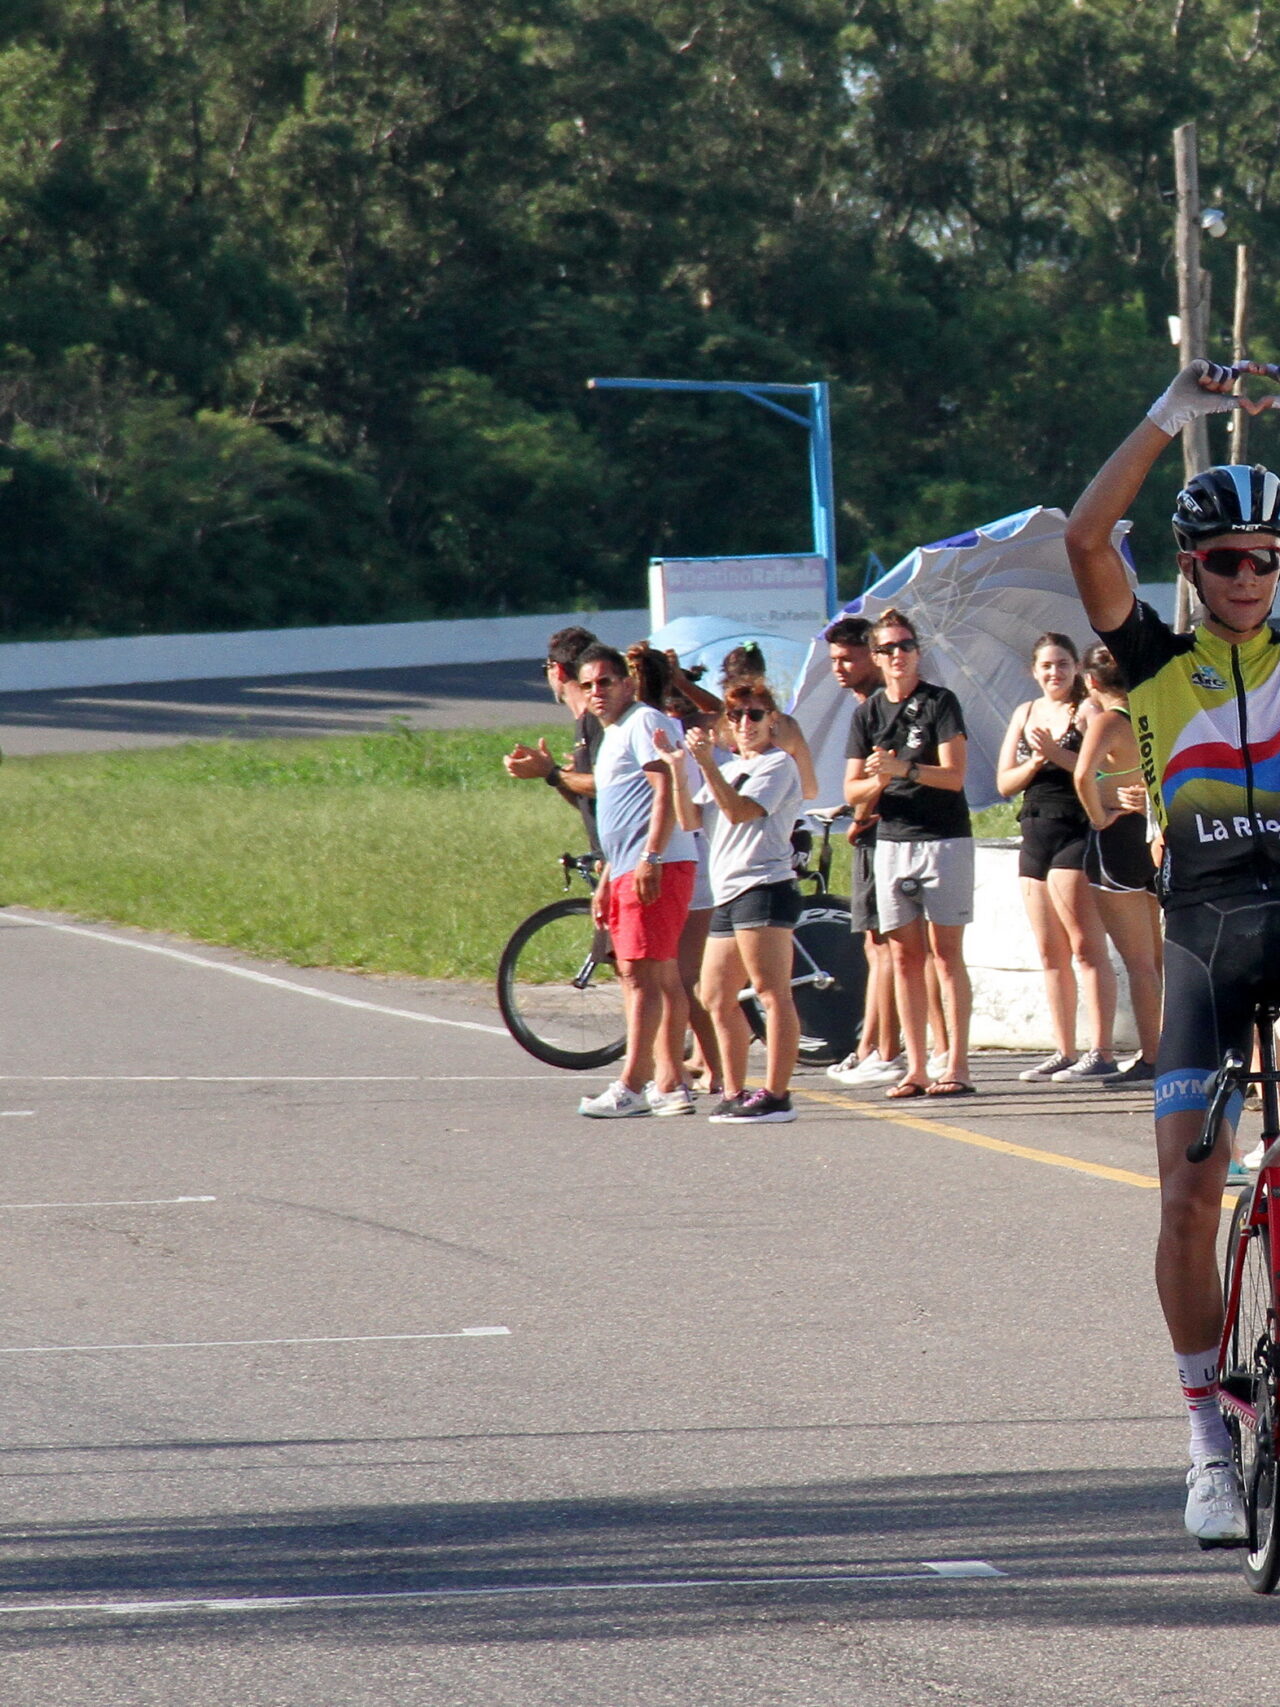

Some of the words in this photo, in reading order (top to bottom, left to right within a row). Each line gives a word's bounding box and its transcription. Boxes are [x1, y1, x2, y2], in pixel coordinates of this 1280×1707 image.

[1232, 524, 1262, 532] MET
[1138, 715, 1157, 787] Rioja
[1195, 813, 1229, 843] La
[1204, 1365, 1215, 1381] U
